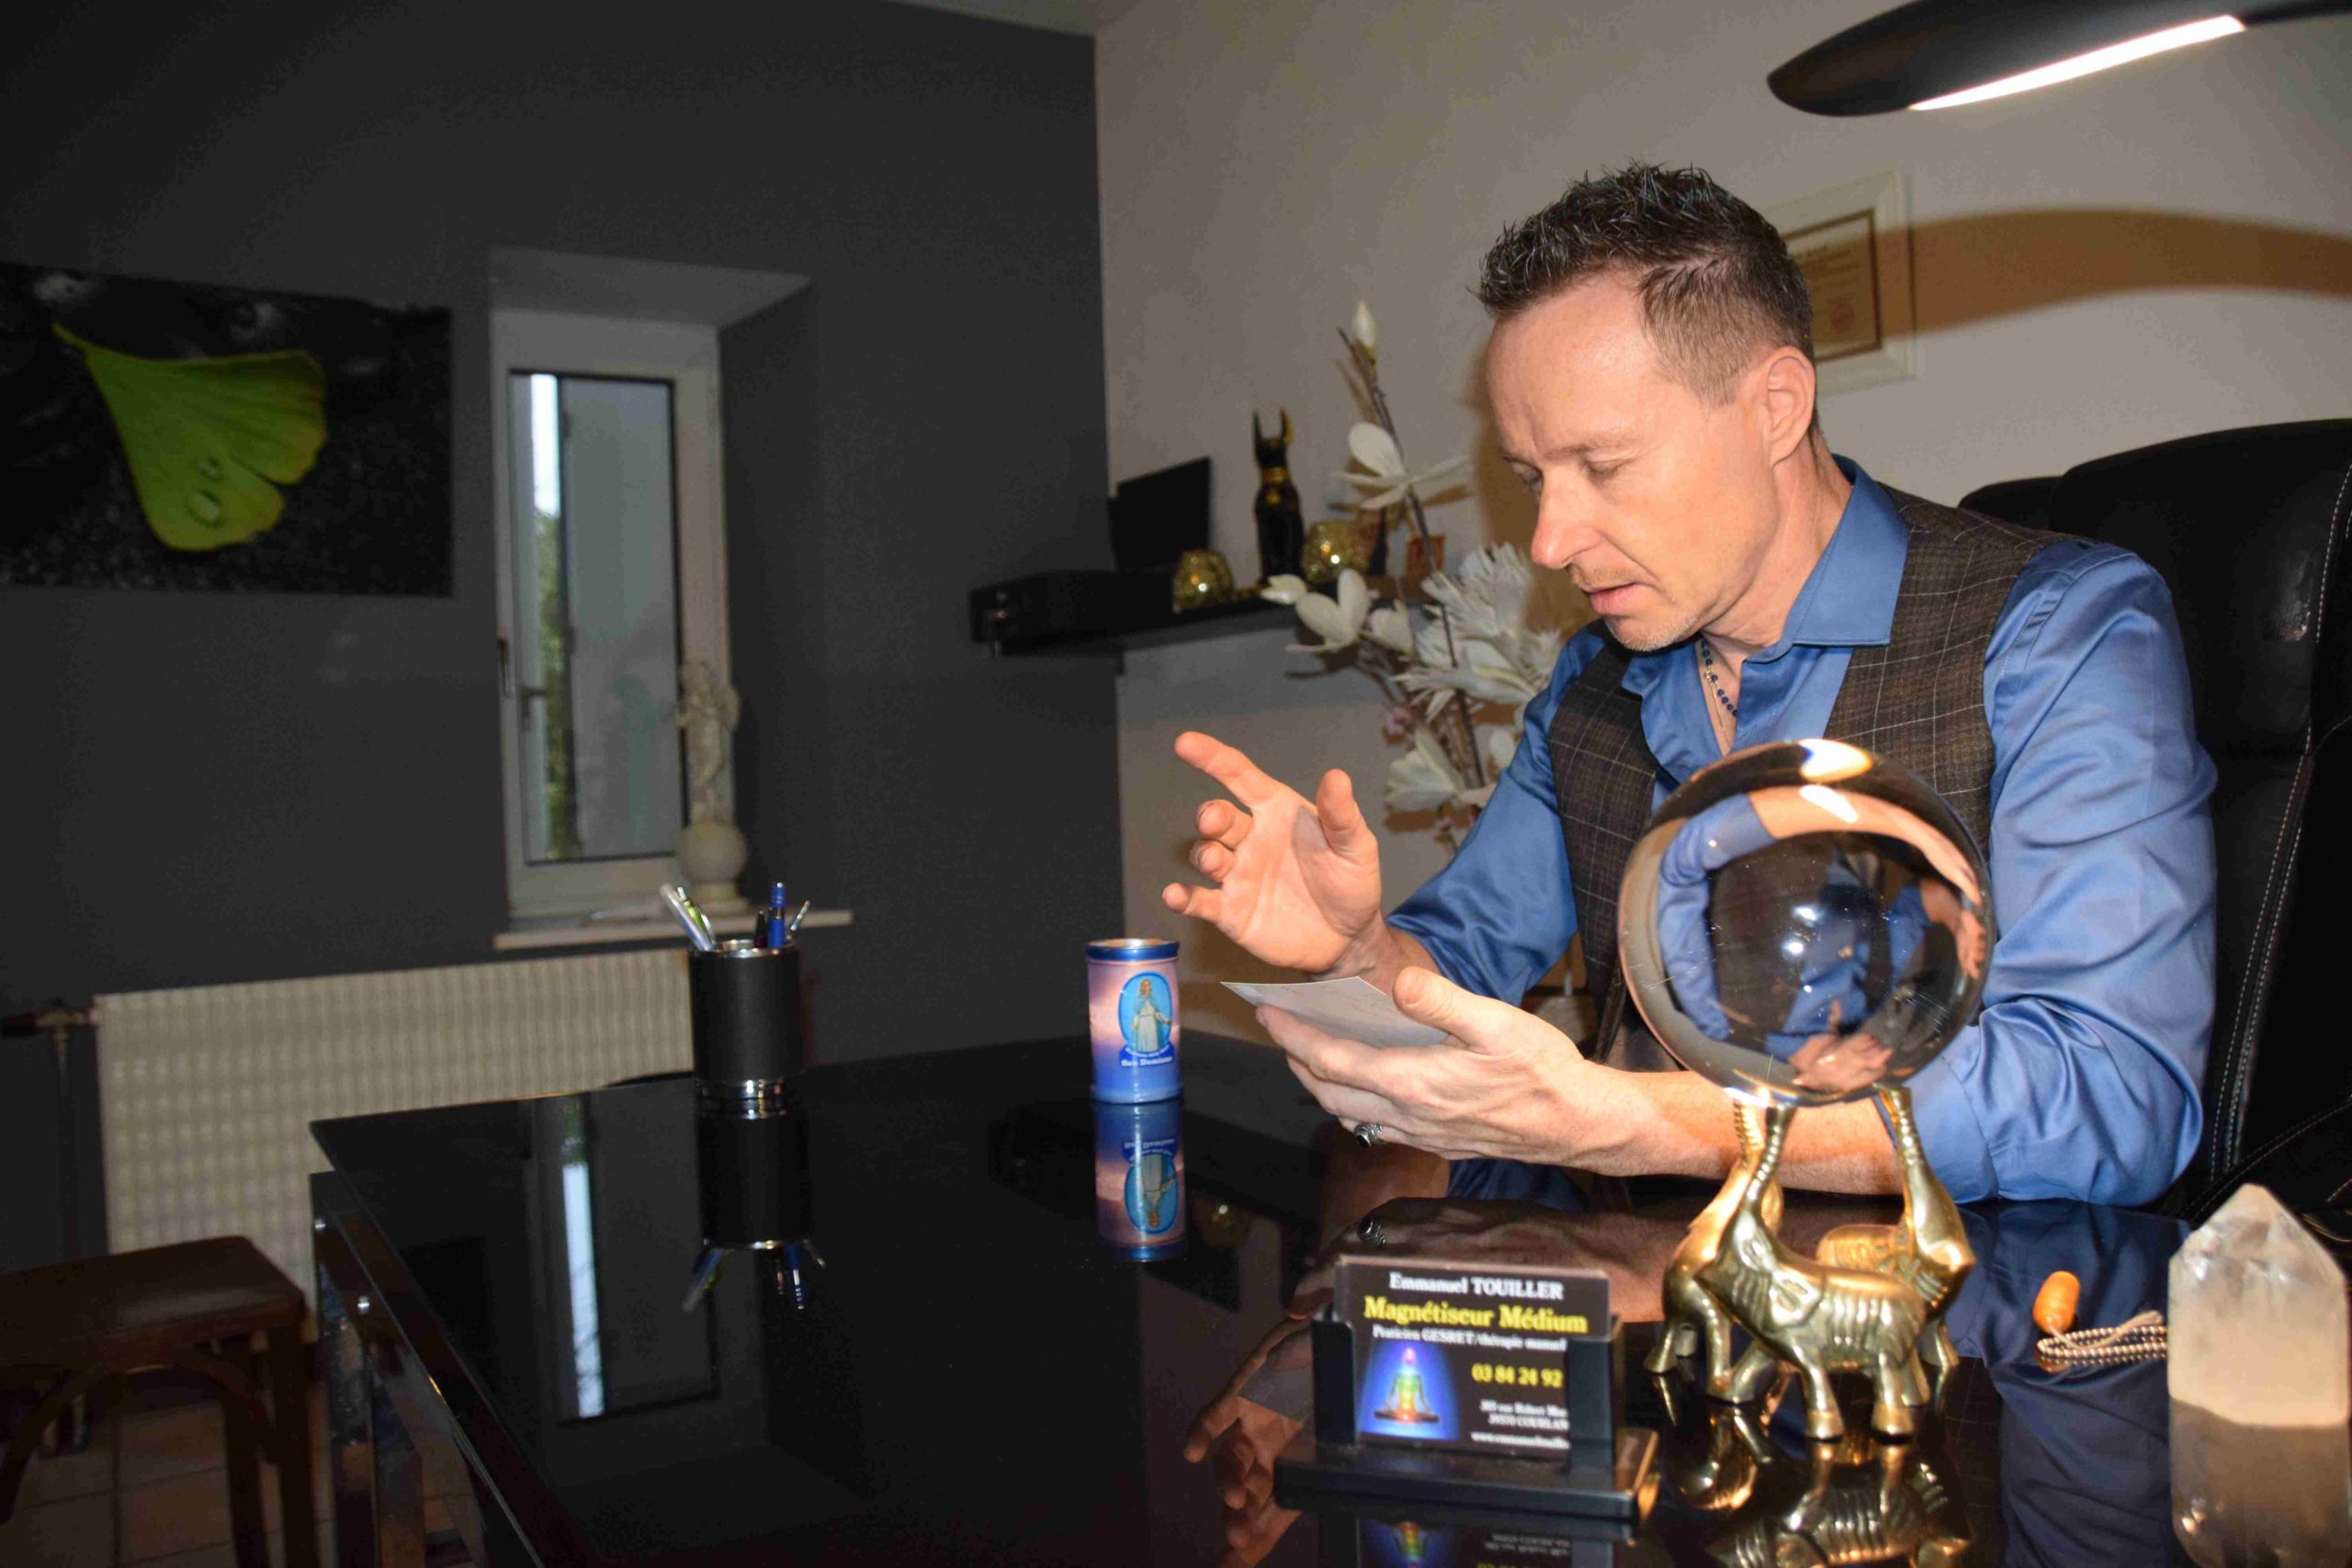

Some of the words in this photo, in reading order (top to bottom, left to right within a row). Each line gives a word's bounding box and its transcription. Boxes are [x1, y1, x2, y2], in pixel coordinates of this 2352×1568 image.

[1389, 1271, 1469, 1294] Emmanuel
[1471, 1277, 1565, 1300] TOUILLER
[1363, 1295, 1495, 1326] Magnétiseur
[1499, 1304, 1589, 1334] Médium
[1471, 1363, 1493, 1382] 03
[1495, 1364, 1515, 1384] 84
[1518, 1366, 1538, 1386] 24
[1541, 1368, 1564, 1388] 92
